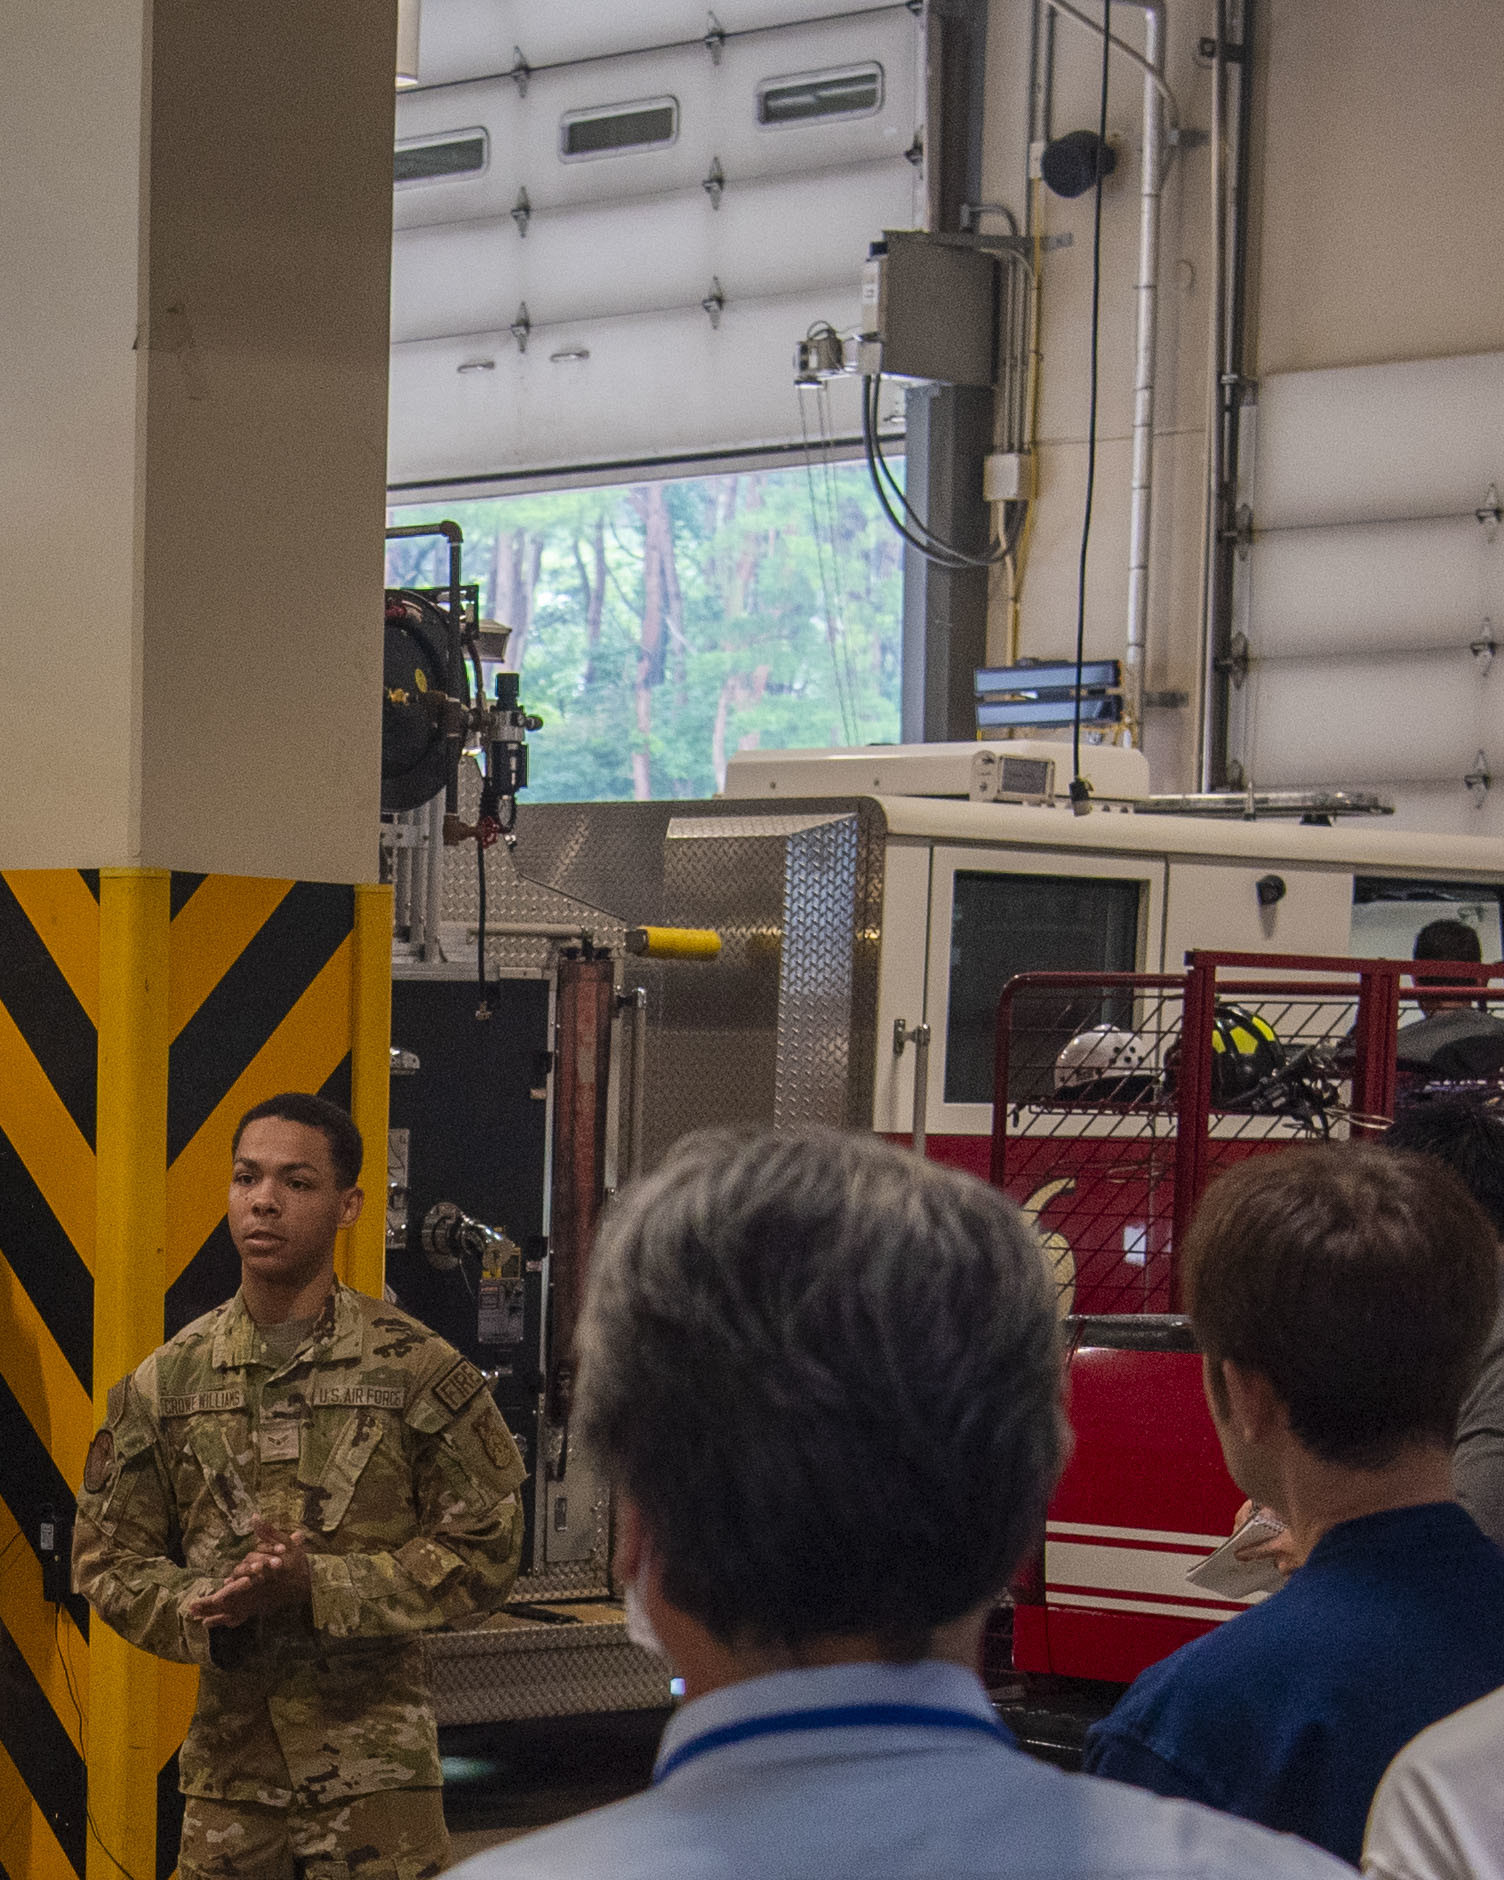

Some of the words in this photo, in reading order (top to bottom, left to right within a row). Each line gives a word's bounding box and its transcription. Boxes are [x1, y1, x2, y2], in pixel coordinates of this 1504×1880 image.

[344, 1387, 364, 1404] AIR
[366, 1389, 402, 1407] FORCE
[439, 1364, 484, 1407] FIRE
